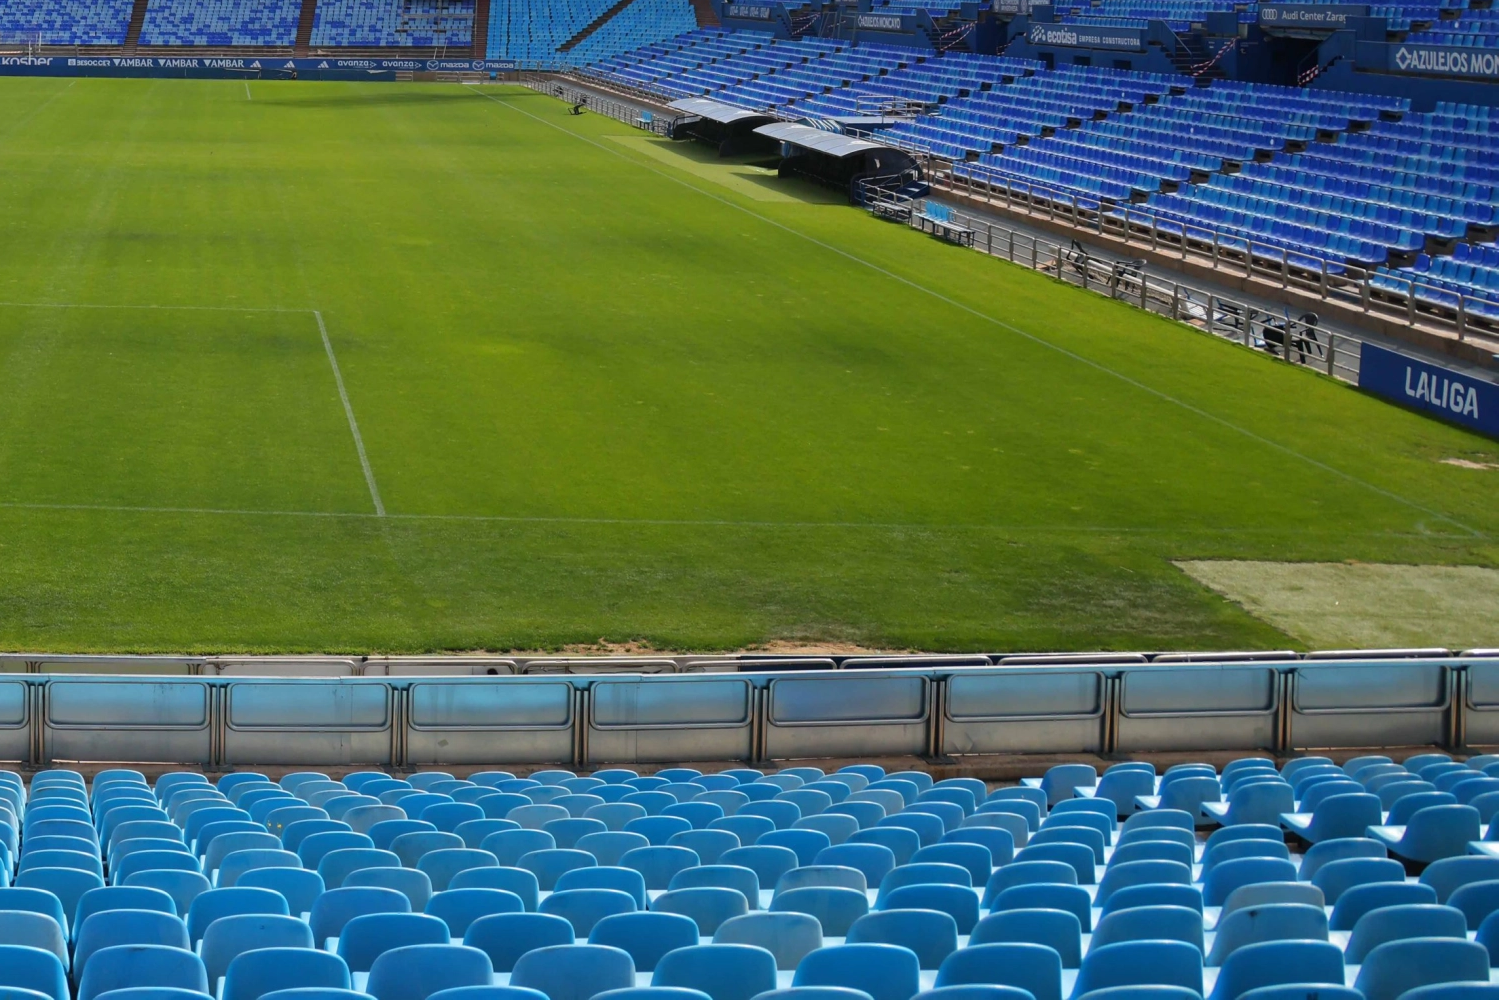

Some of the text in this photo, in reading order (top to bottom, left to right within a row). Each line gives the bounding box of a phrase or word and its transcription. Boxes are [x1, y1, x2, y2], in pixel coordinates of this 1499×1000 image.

[1282, 11, 1299, 20] Audi
[1300, 11, 1324, 21] Center
[1047, 27, 1140, 46] ecotisa EMPRESA CONSTRUCTORA
[2, 56, 54, 66] kosher
[120, 58, 154, 67] AMBAR
[165, 58, 199, 67] AMBAR
[211, 59, 244, 67] AMBAR
[1410, 50, 1469, 73] AZULEJOS
[1405, 366, 1479, 419] LALIGA
